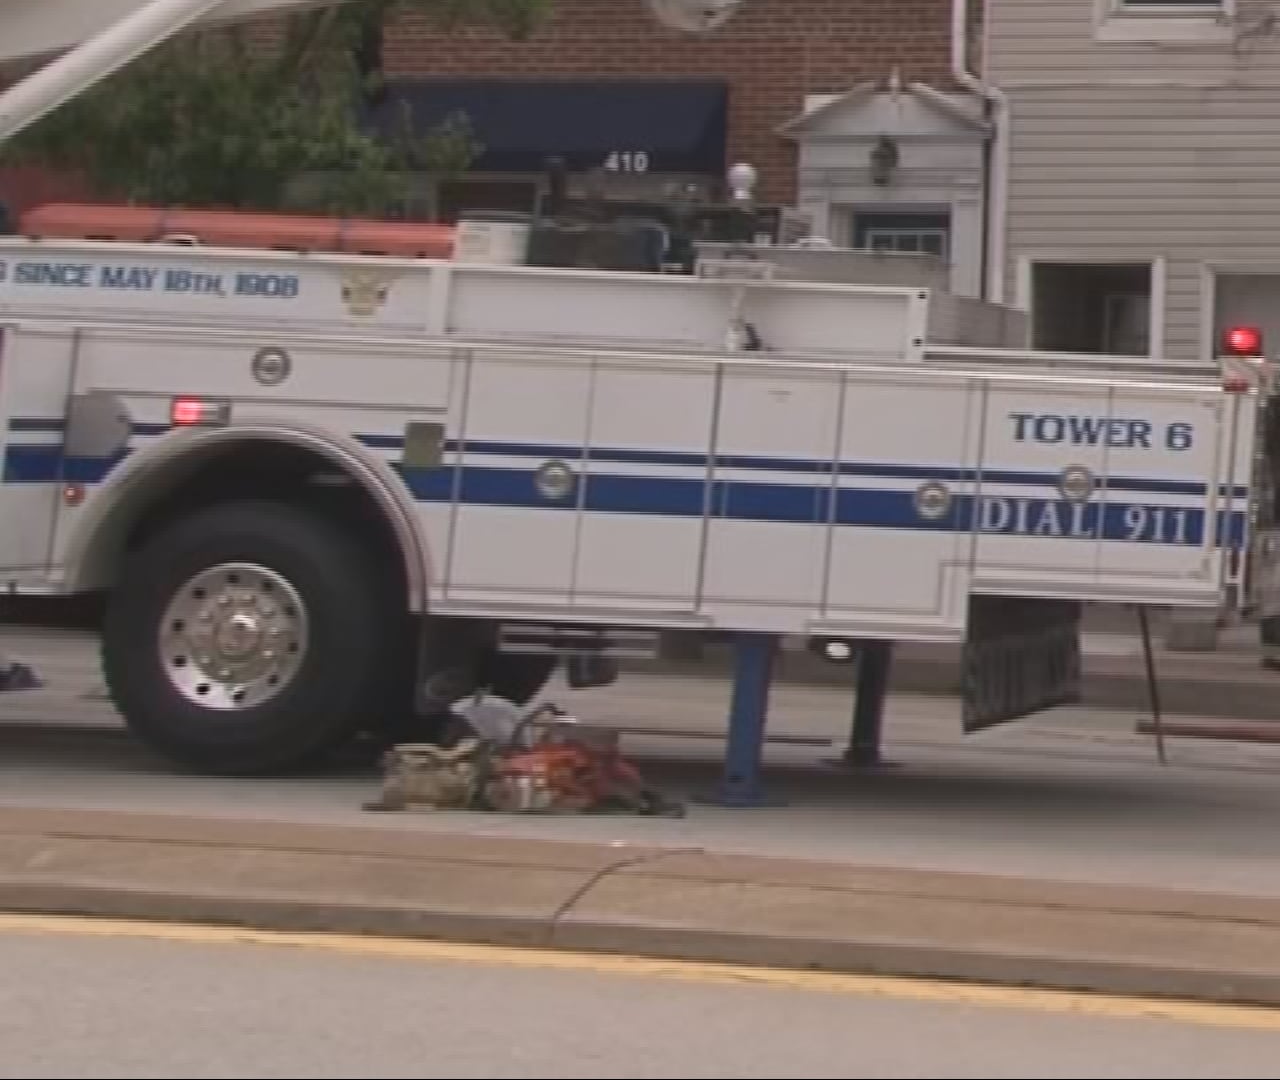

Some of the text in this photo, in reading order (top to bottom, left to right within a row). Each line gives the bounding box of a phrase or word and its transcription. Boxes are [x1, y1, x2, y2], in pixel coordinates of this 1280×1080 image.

[603, 151, 649, 172] 410
[14, 261, 92, 288] SINCE
[101, 265, 159, 292] MAY
[234, 273, 300, 299] 1908
[1008, 412, 1194, 452] TOWER 6
[980, 498, 1188, 541] DIAL 911
